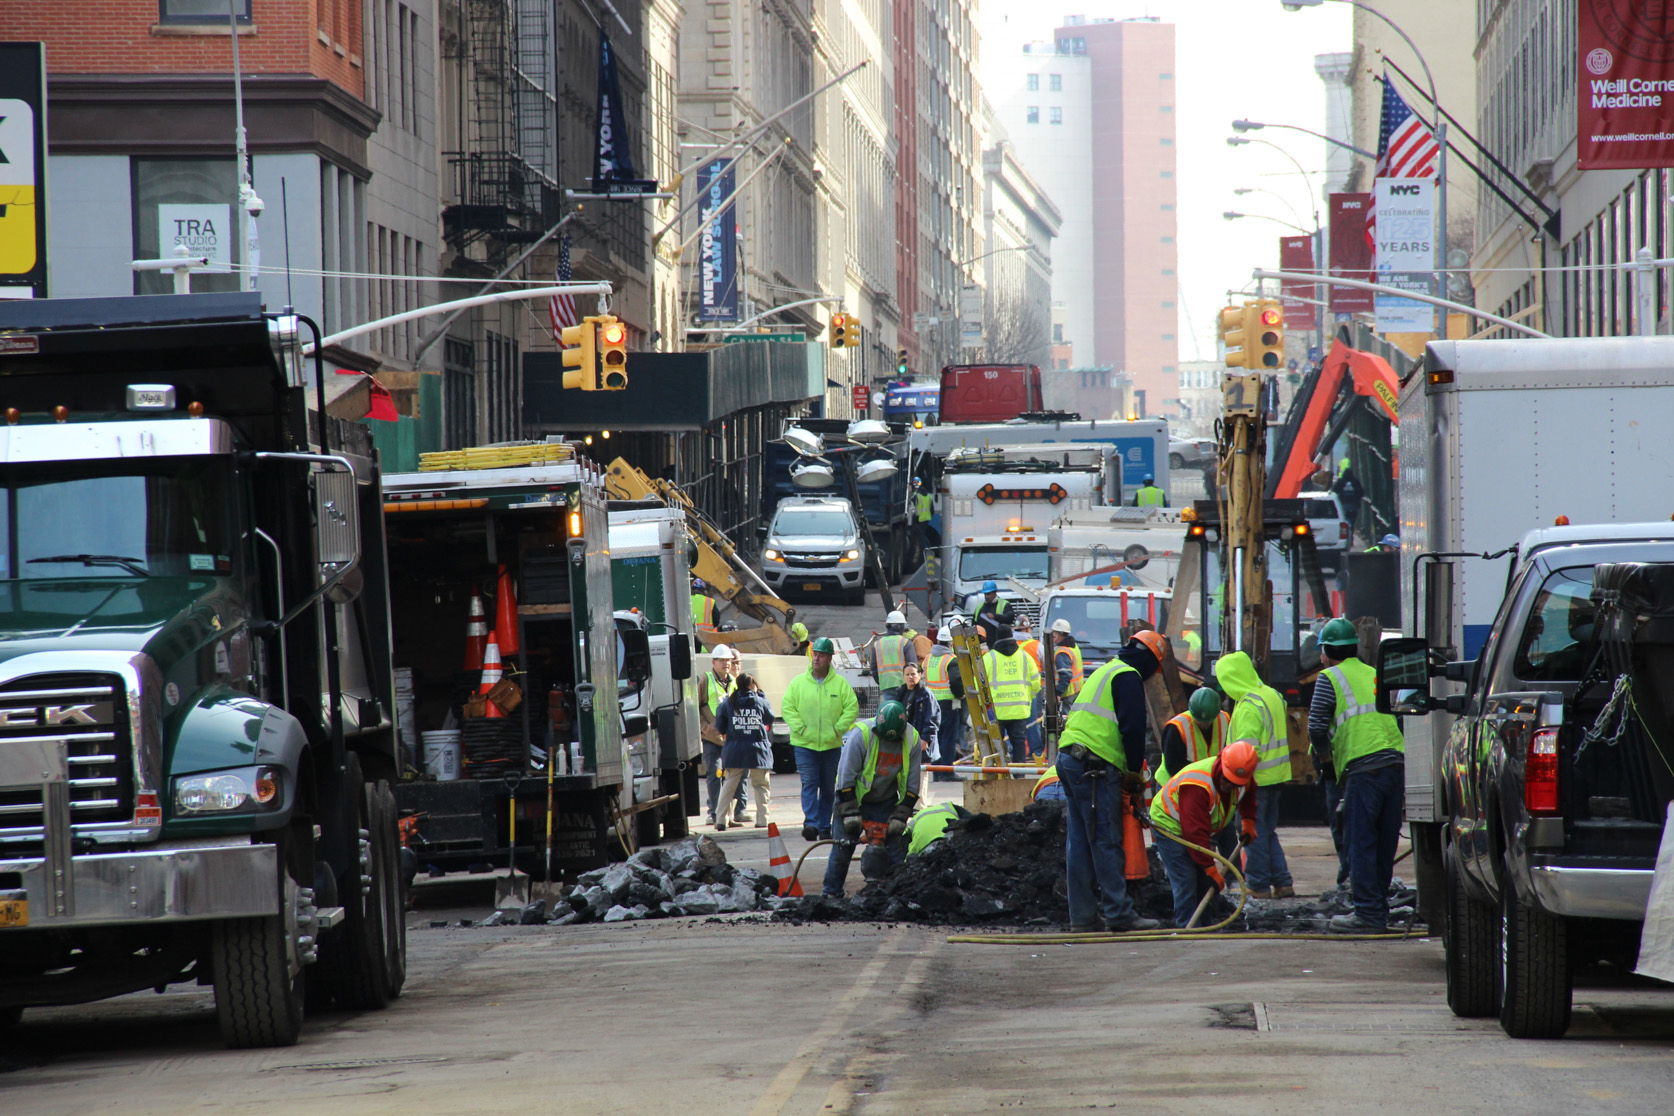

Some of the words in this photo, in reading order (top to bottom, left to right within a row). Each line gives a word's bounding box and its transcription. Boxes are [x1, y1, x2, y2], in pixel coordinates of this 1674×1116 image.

[1590, 79, 1627, 93] Weill
[1629, 78, 1674, 92] Corne
[1591, 93, 1662, 108] Medicine
[1390, 185, 1420, 196] NYC
[1379, 209, 1430, 217] CELEBRATING
[174, 219, 217, 236] TRA
[1378, 217, 1431, 240] 125
[174, 235, 218, 246] STUDIO
[1379, 242, 1430, 252] YEARS
[711, 240, 722, 283] LAW
[702, 263, 714, 305] NEW
[983, 370, 999, 379] 150
[623, 556, 657, 566] DEJANA
